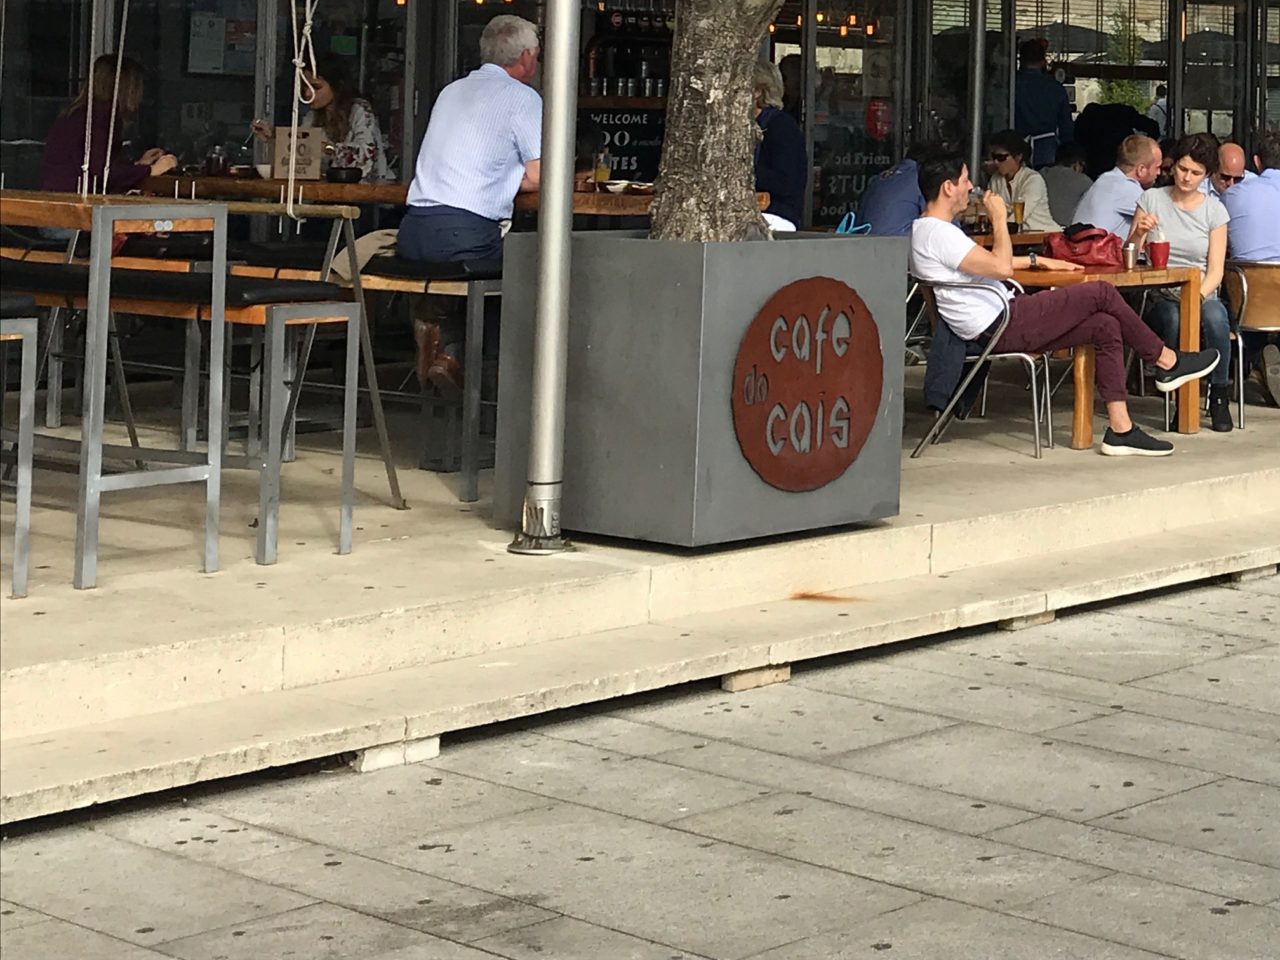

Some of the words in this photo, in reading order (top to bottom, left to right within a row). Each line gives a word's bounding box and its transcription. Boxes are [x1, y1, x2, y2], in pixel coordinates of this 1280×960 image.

[590, 113, 649, 124] WELCOME
[854, 152, 890, 165] Frien
[744, 364, 769, 405] do
[766, 391, 851, 456] cais
